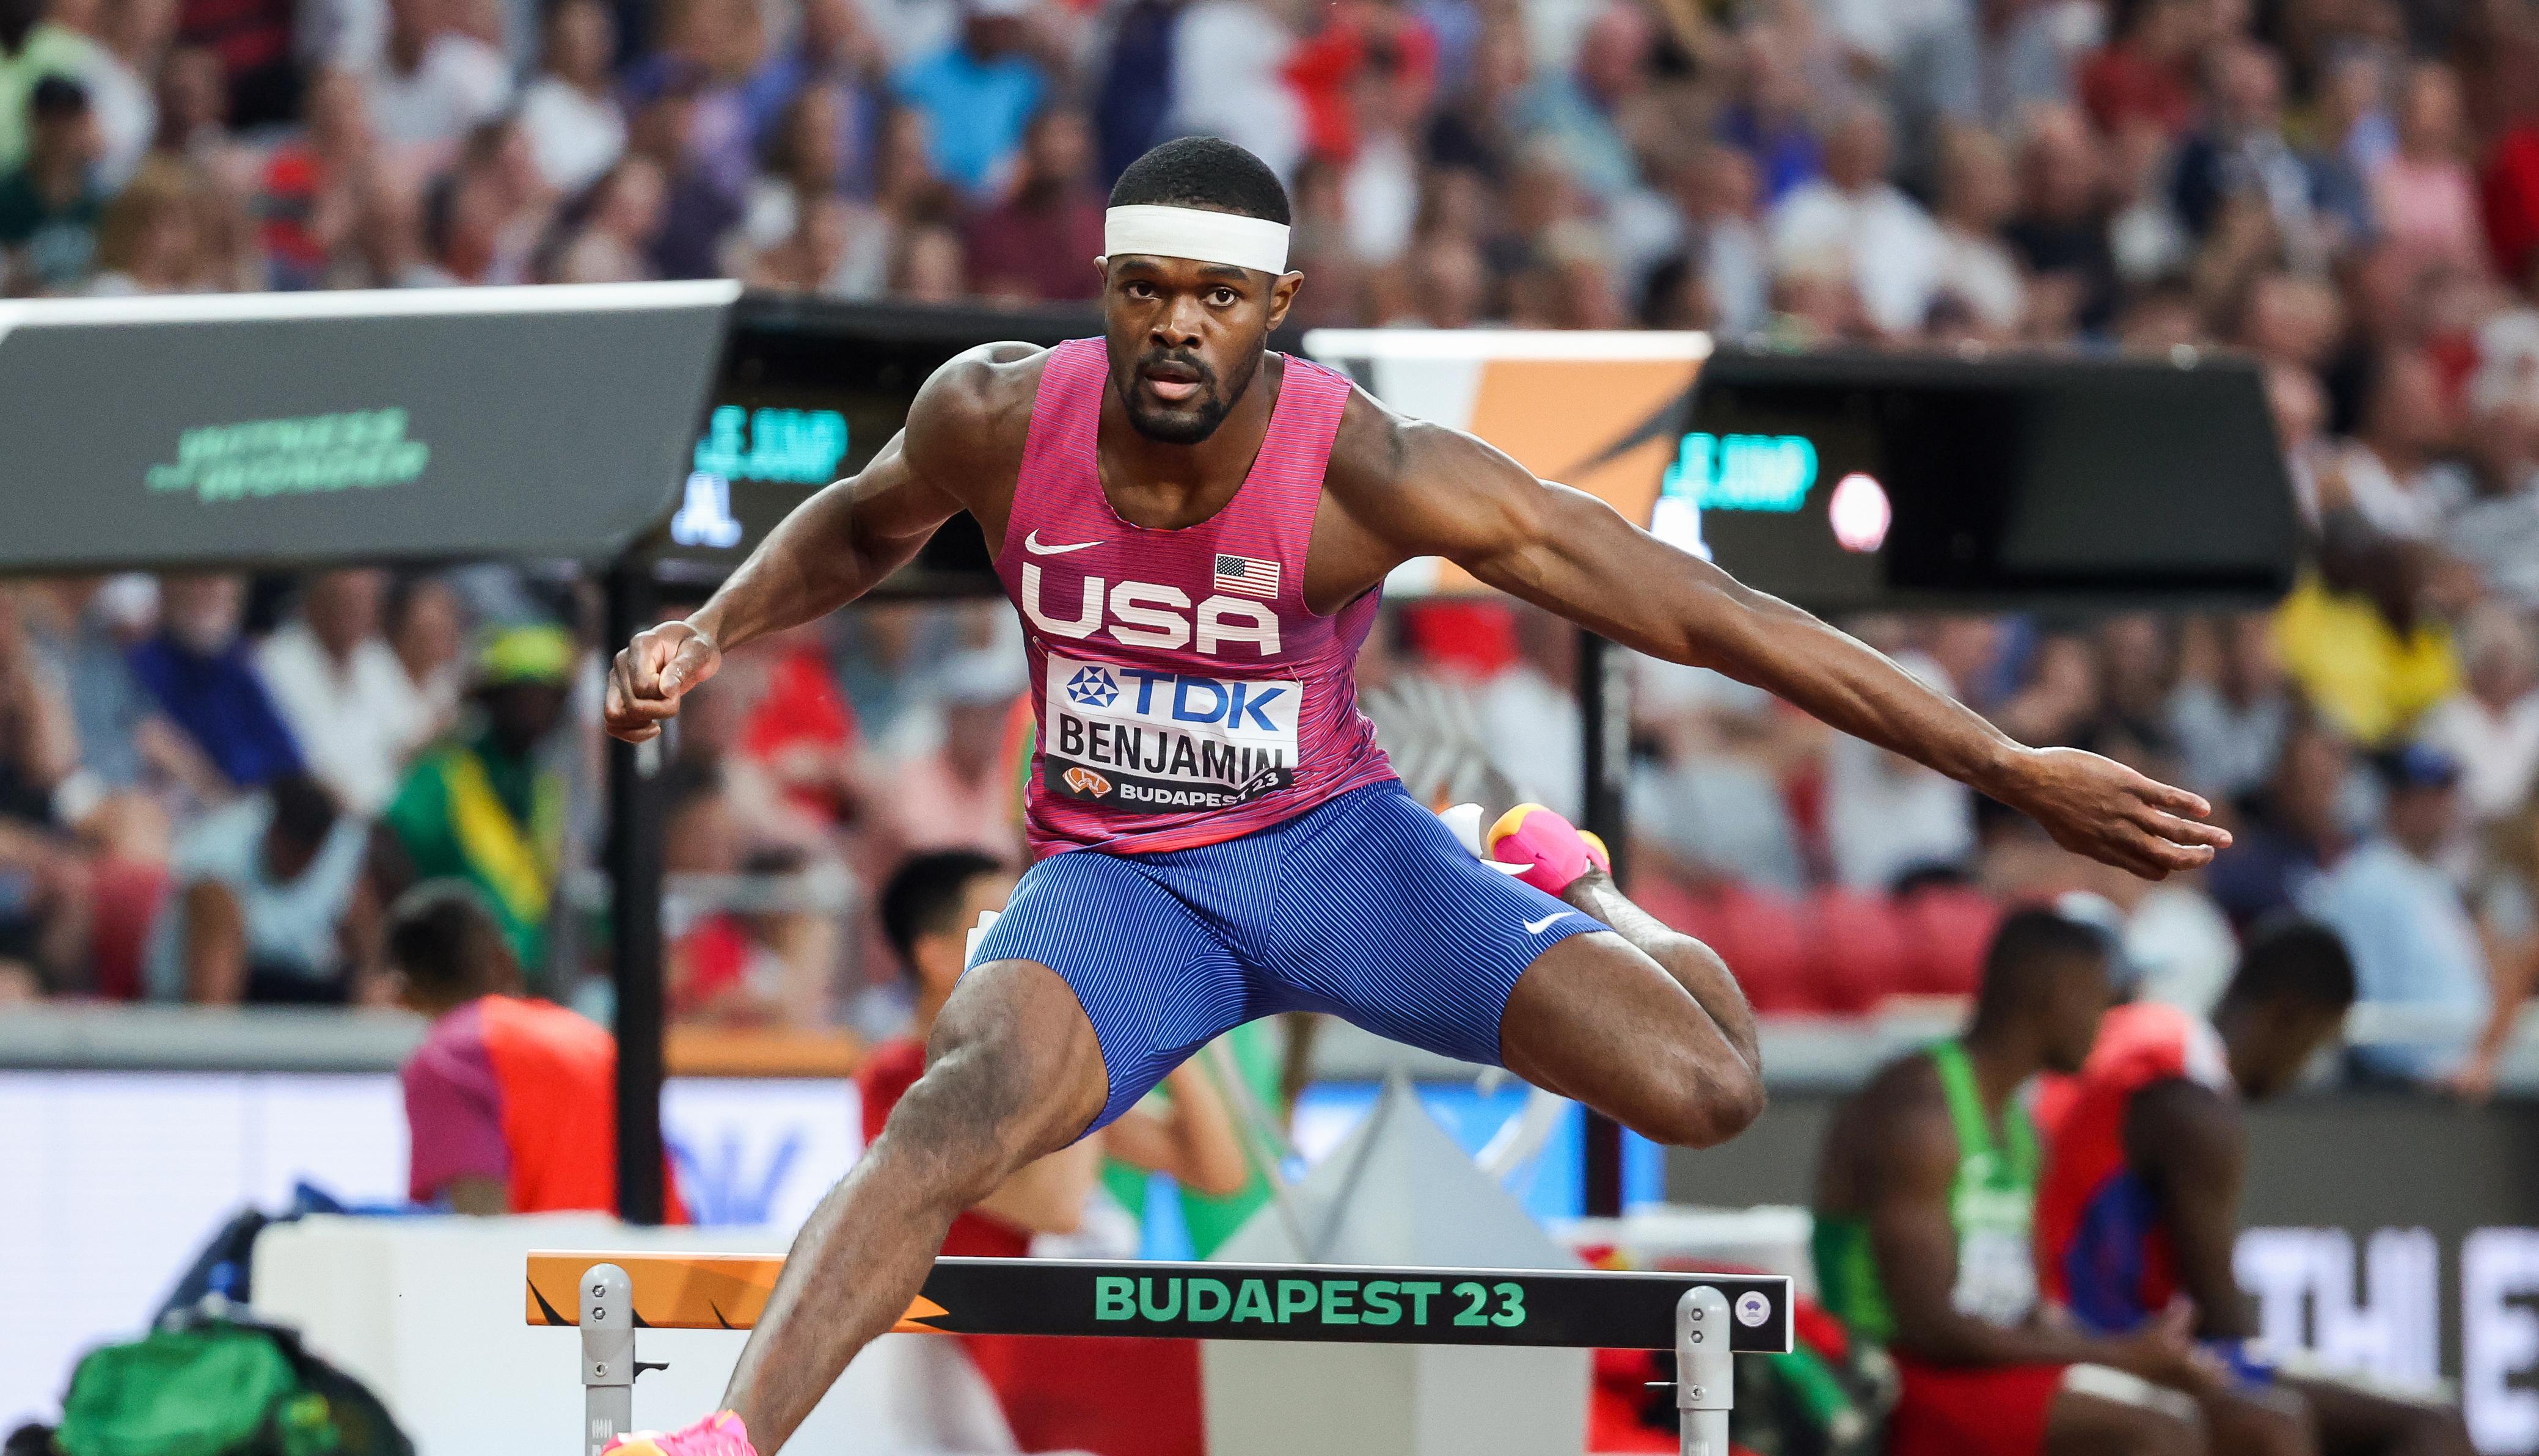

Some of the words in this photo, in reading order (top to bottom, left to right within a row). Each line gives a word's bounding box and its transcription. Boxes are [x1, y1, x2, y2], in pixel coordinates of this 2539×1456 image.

[1021, 561, 1282, 657] USA
[1119, 668, 1287, 731] TDK
[1059, 713, 1283, 786] BENJAMIN
[1120, 783, 1249, 807] BUDAPEST
[1252, 772, 1279, 792] 23
[1095, 1276, 1441, 1325] BUDAPEST
[1453, 1282, 1527, 1327] 23
